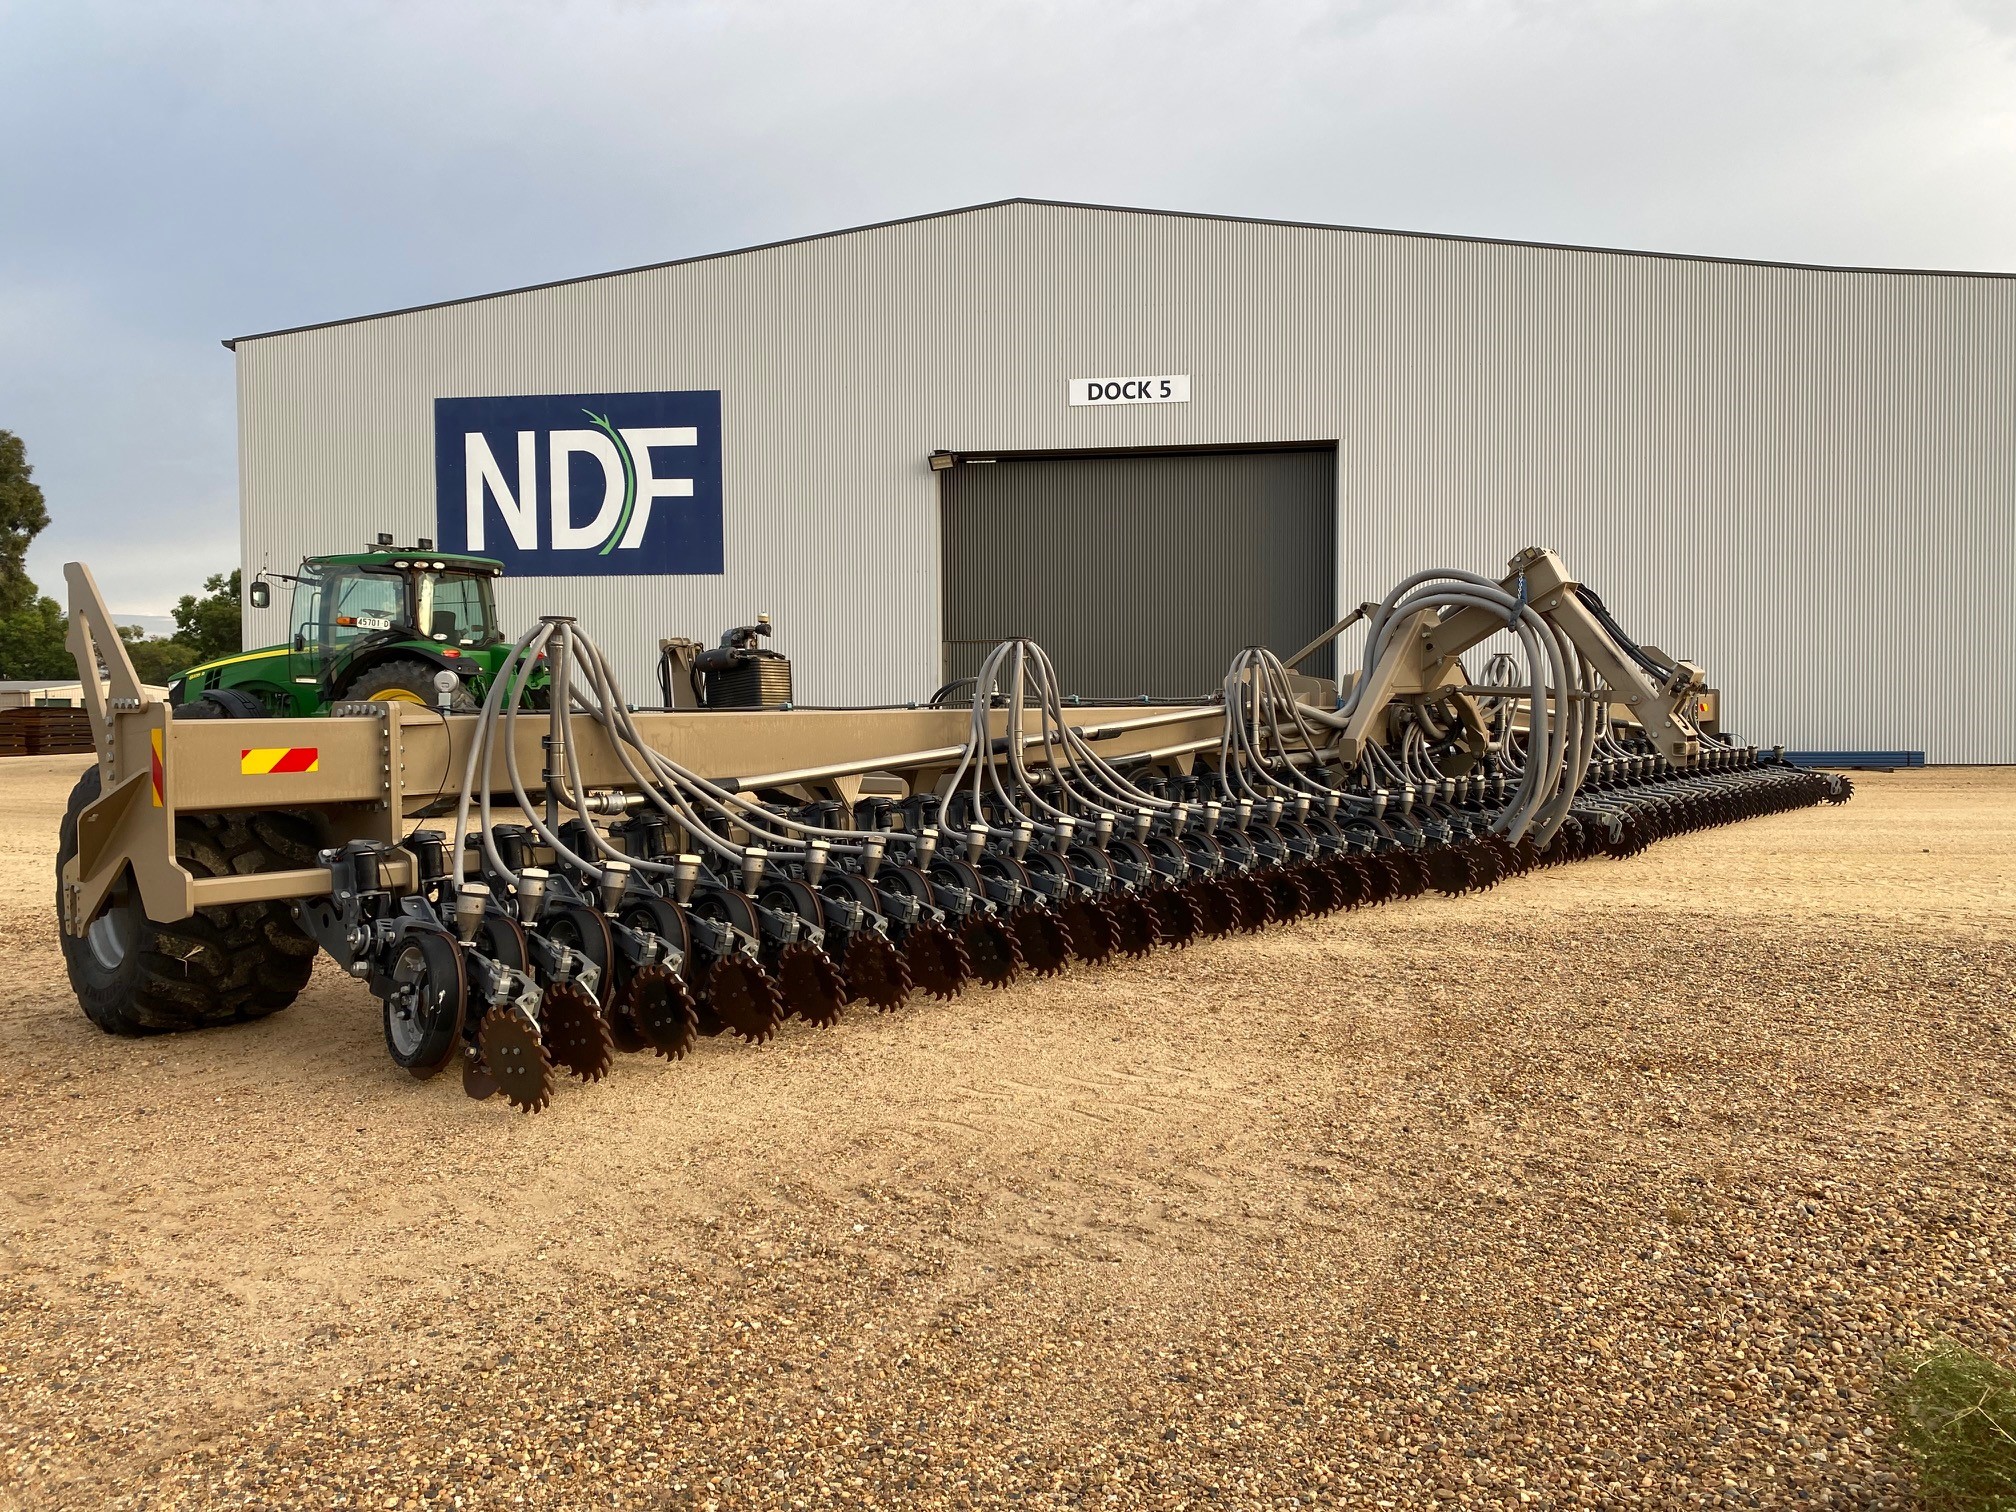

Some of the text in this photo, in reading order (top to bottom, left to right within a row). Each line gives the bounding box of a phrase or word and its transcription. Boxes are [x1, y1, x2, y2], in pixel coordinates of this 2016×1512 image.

[1088, 380, 1171, 401] DOCK 5
[465, 427, 698, 551] NDF
[357, 618, 380, 627] 45701
